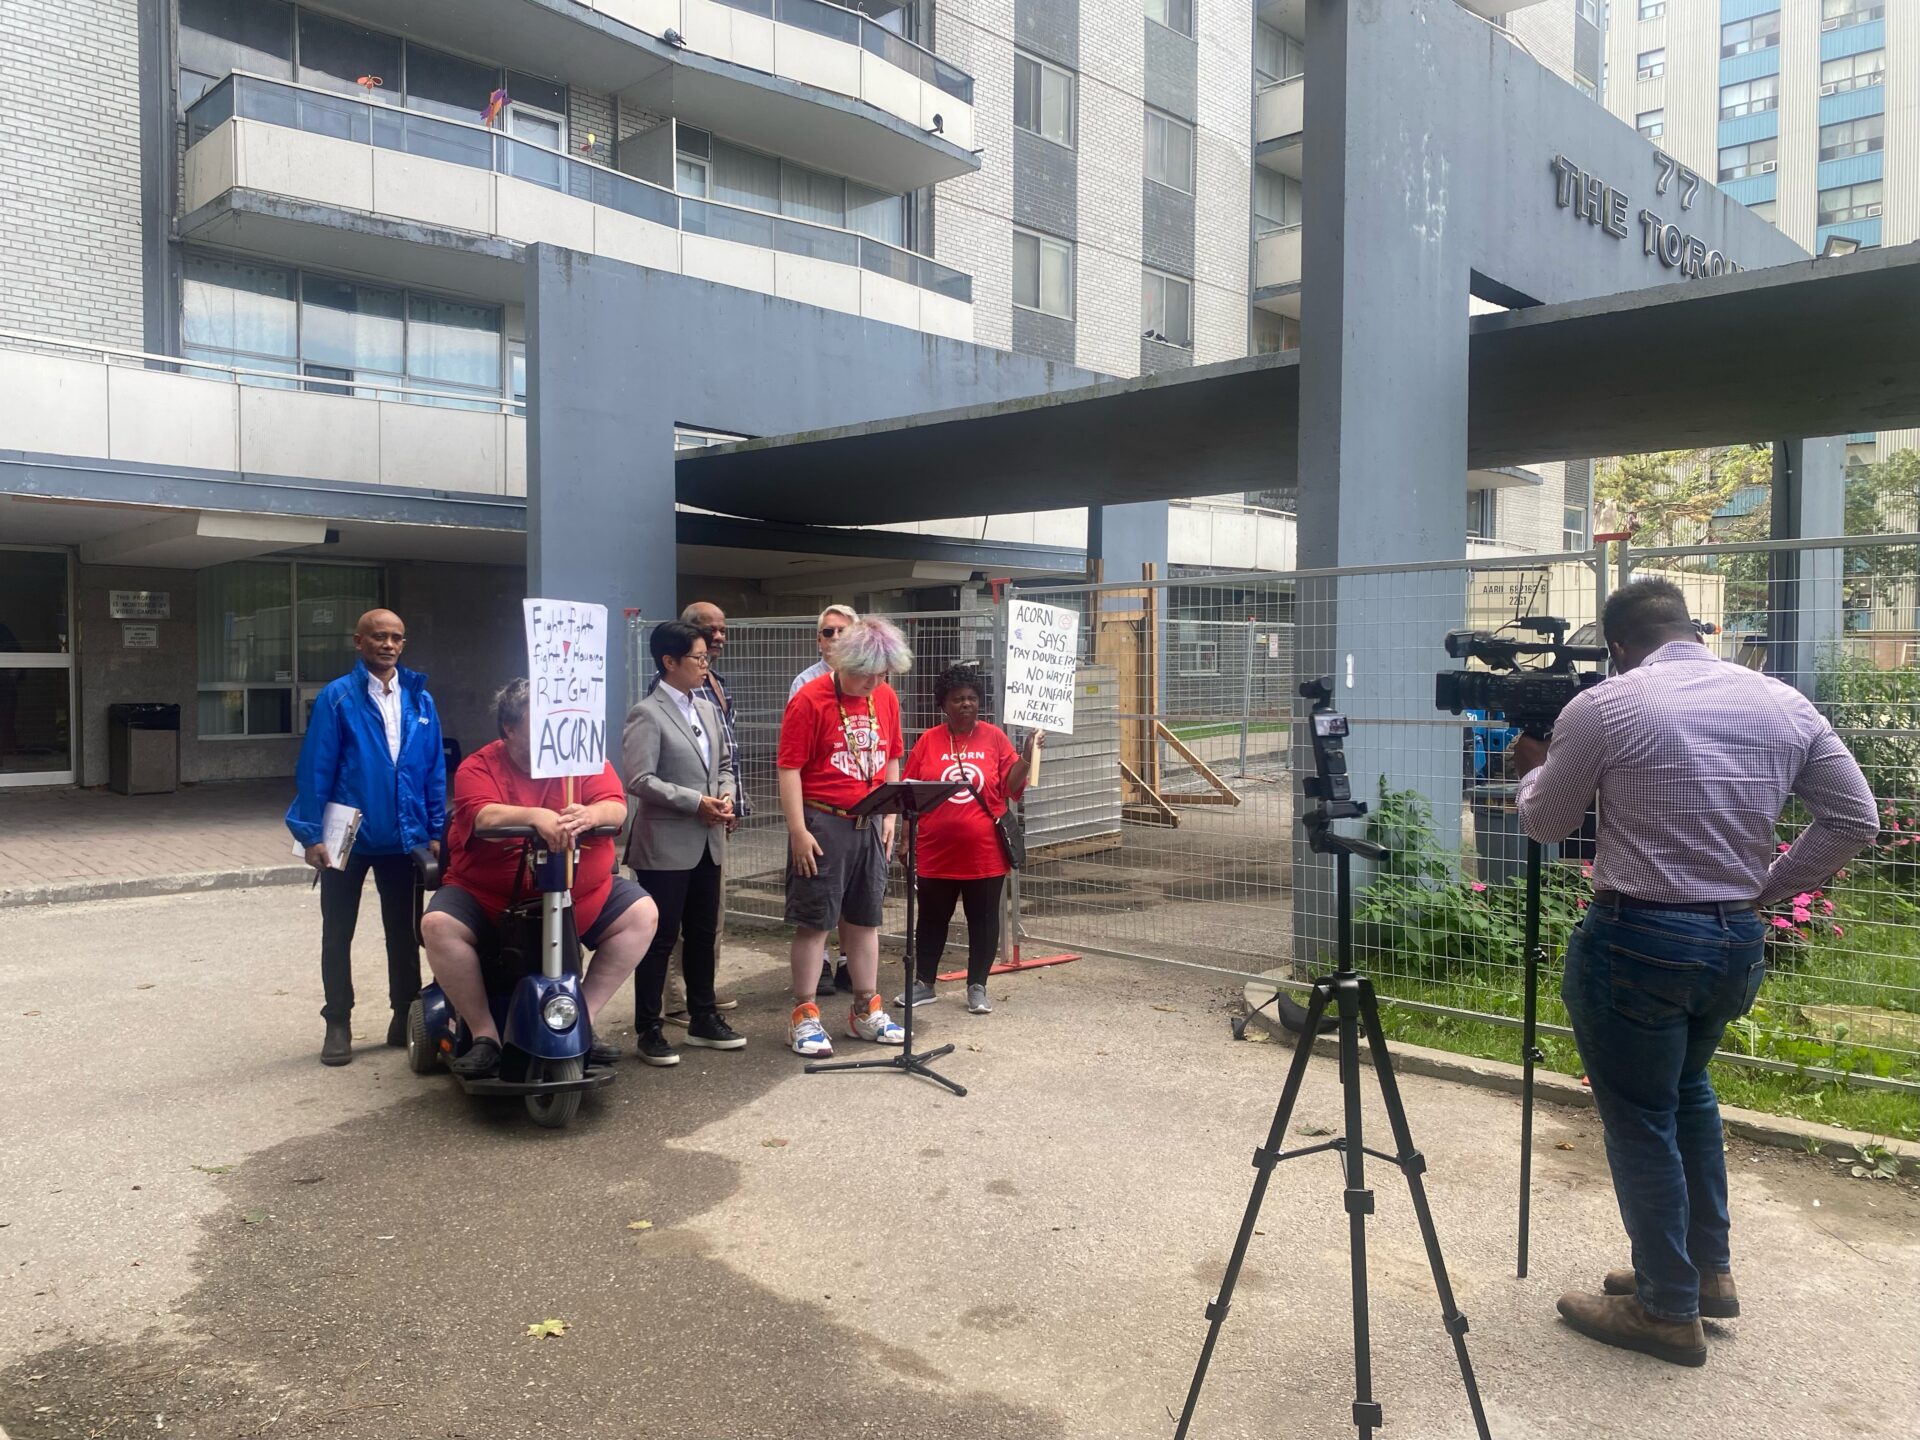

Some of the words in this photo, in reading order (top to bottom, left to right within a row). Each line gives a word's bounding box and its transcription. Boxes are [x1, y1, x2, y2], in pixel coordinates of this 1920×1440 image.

[1654, 150, 1700, 210] 77
[1554, 154, 1629, 239] THE
[1639, 208, 1745, 279] TORO
[1016, 605, 1053, 627] ACORN
[1027, 666, 1044, 680] NO
[536, 676, 604, 707] RIGHT
[1038, 686, 1073, 704] UNFAIR
[1026, 699, 1059, 713] RENT
[1013, 709, 1066, 727] INCREASES
[537, 717, 605, 769] ACORN
[941, 751, 985, 761] ACORN
